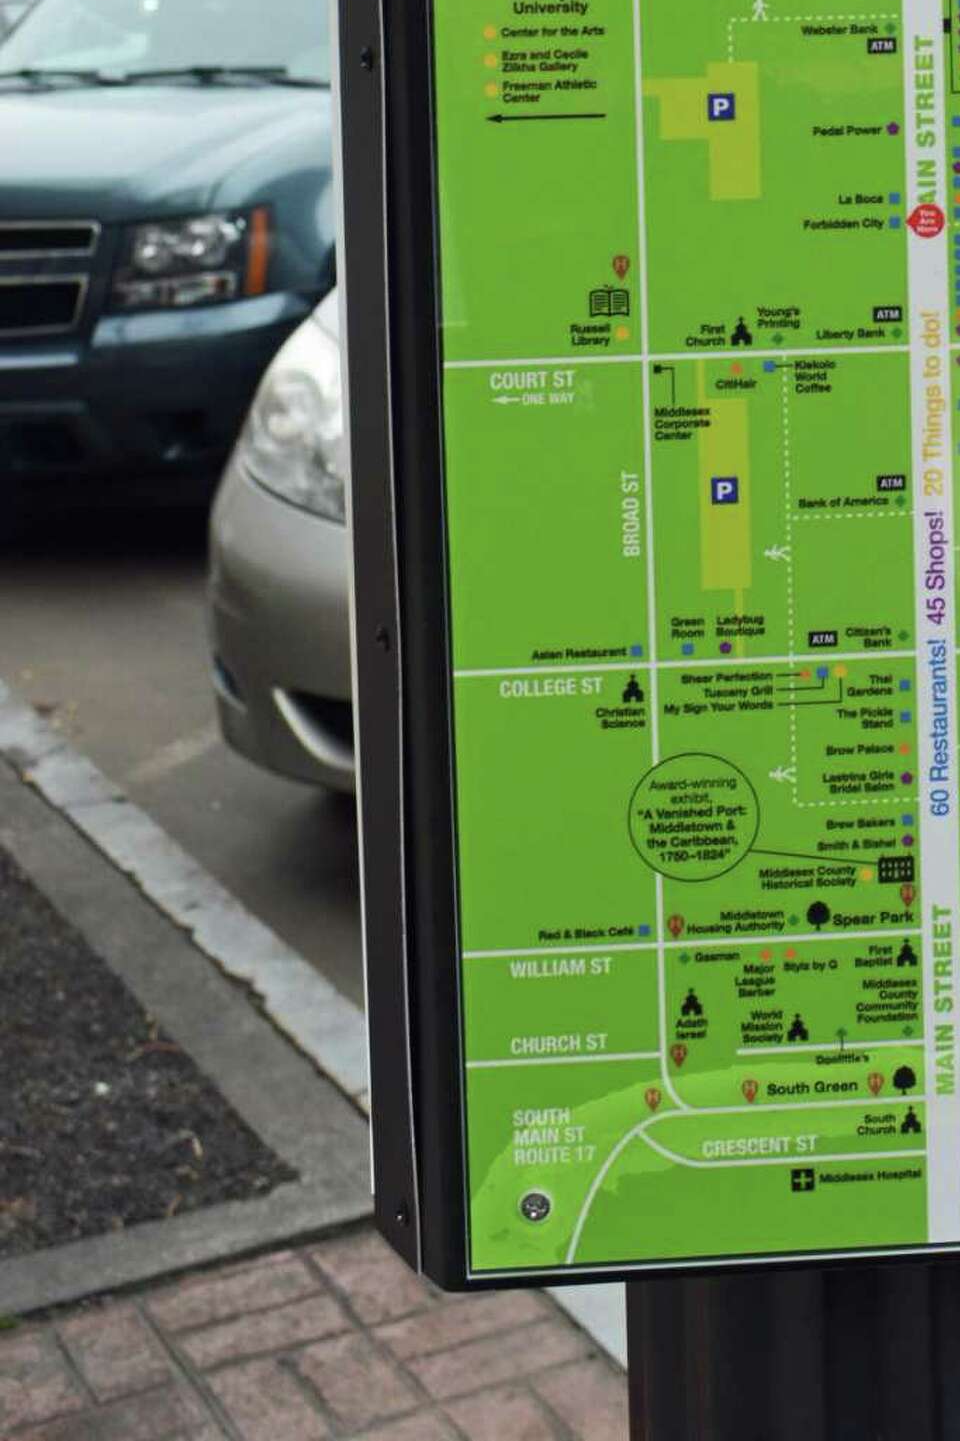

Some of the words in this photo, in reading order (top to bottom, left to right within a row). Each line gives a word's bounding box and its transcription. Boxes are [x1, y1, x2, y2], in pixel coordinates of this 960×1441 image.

[514, 1, 588, 16] University
[869, 39, 894, 52] ATM
[915, 35, 935, 147] STREET
[876, 309, 900, 320] ATM
[816, 329, 853, 341] Liberty
[857, 327, 885, 339] Bank
[491, 372, 548, 390] COURT
[553, 371, 575, 388] ST
[523, 392, 545, 404] ONE
[548, 391, 574, 404] WAY
[622, 471, 639, 494] ST
[880, 477, 903, 489] ATM
[623, 498, 640, 557] BROAD
[925, 512, 948, 591] Shops!
[927, 598, 945, 625] 45
[501, 679, 575, 697] COLLEGE
[580, 677, 602, 695] ST
[929, 641, 949, 785] Restaurants!
[932, 791, 949, 815] 60
[833, 913, 876, 928] Spear
[880, 910, 913, 924] Park
[932, 905, 952, 1011] STREET
[511, 960, 584, 979] WILLIAM
[590, 958, 611, 974] ST
[511, 1036, 581, 1054] CHURCH
[586, 1034, 607, 1051] ST
[936, 1025, 954, 1095] MAIN
[767, 1081, 810, 1095] South
[814, 1080, 858, 1094] Green
[513, 1109, 570, 1126] SOUTH
[513, 1129, 559, 1145] MAIN
[564, 1127, 585, 1143] ST
[702, 1138, 792, 1156] CRESCENT
[797, 1136, 818, 1153] ST
[513, 1147, 572, 1164] ROUTE
[579, 1147, 595, 1161] 17
